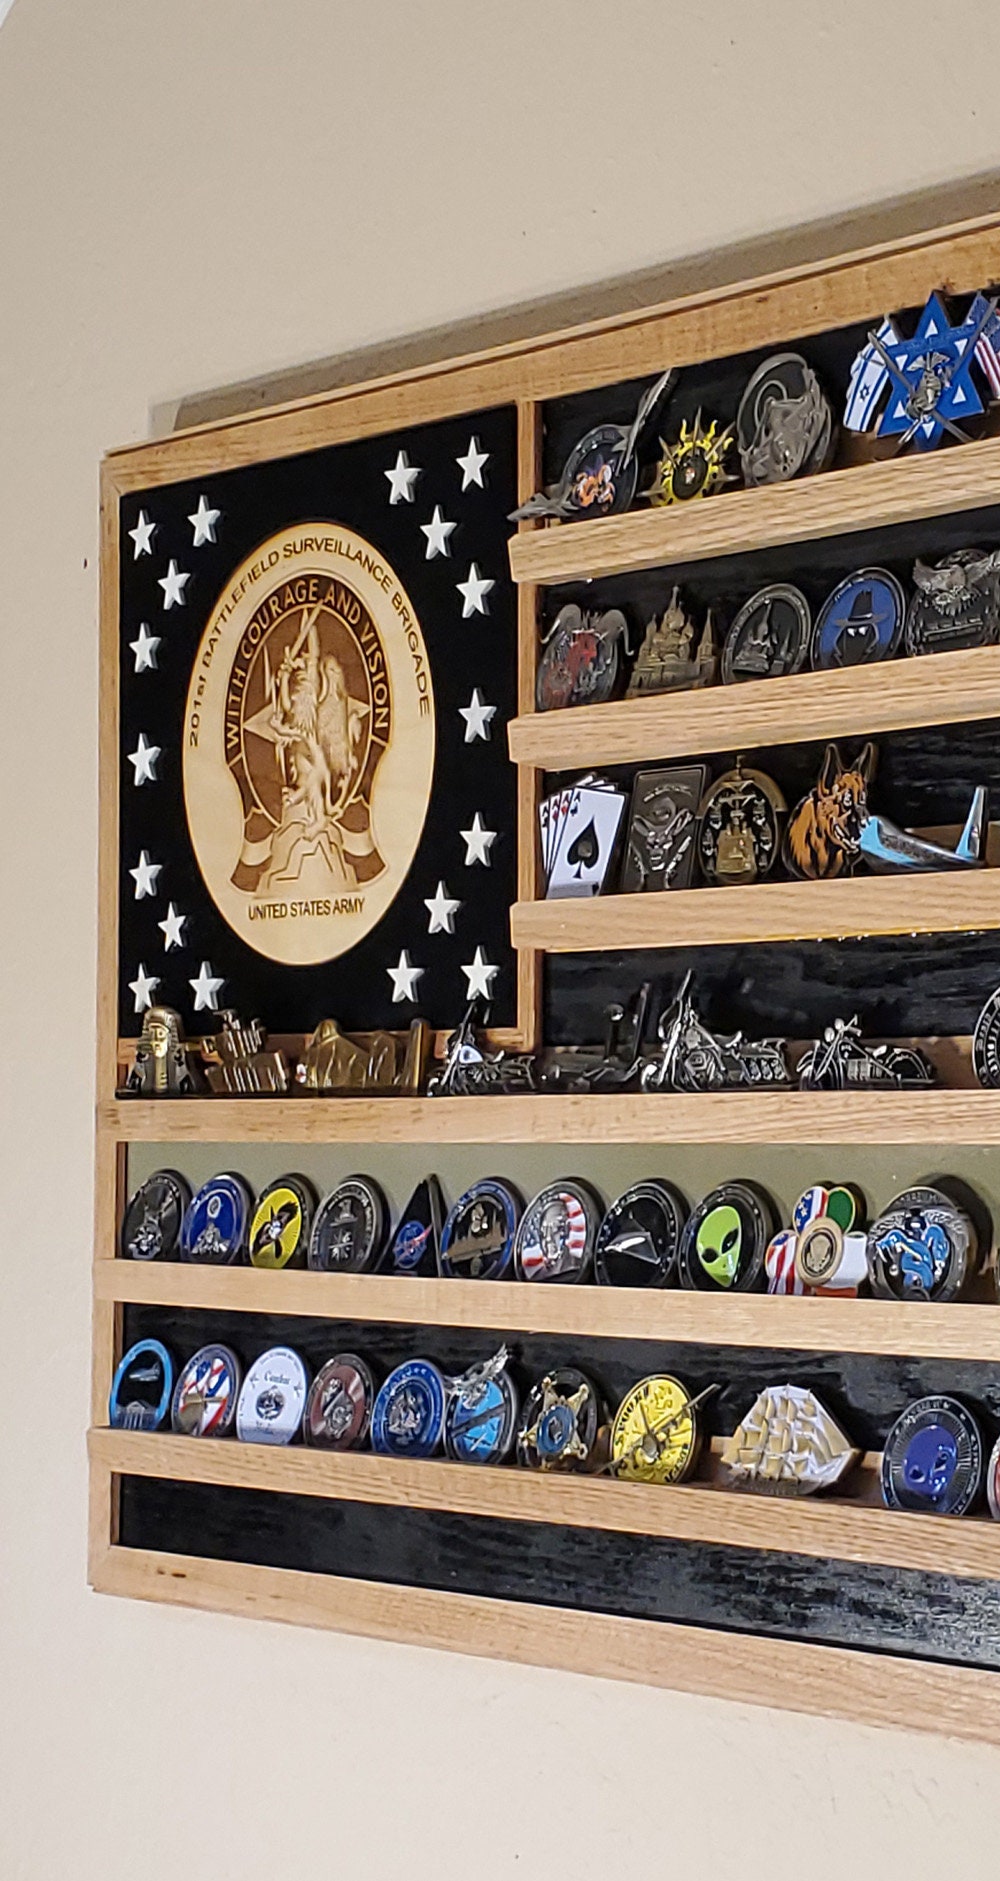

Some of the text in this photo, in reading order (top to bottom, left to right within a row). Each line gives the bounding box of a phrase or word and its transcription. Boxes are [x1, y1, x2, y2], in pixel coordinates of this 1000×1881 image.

[189, 536, 431, 747] 201st BATTLEFIELD SURVEILLANCE BRIGADE
[226, 579, 390, 750] WITH COURAGE AND VISION
[248, 896, 366, 921] UNITED STATES ARMY
